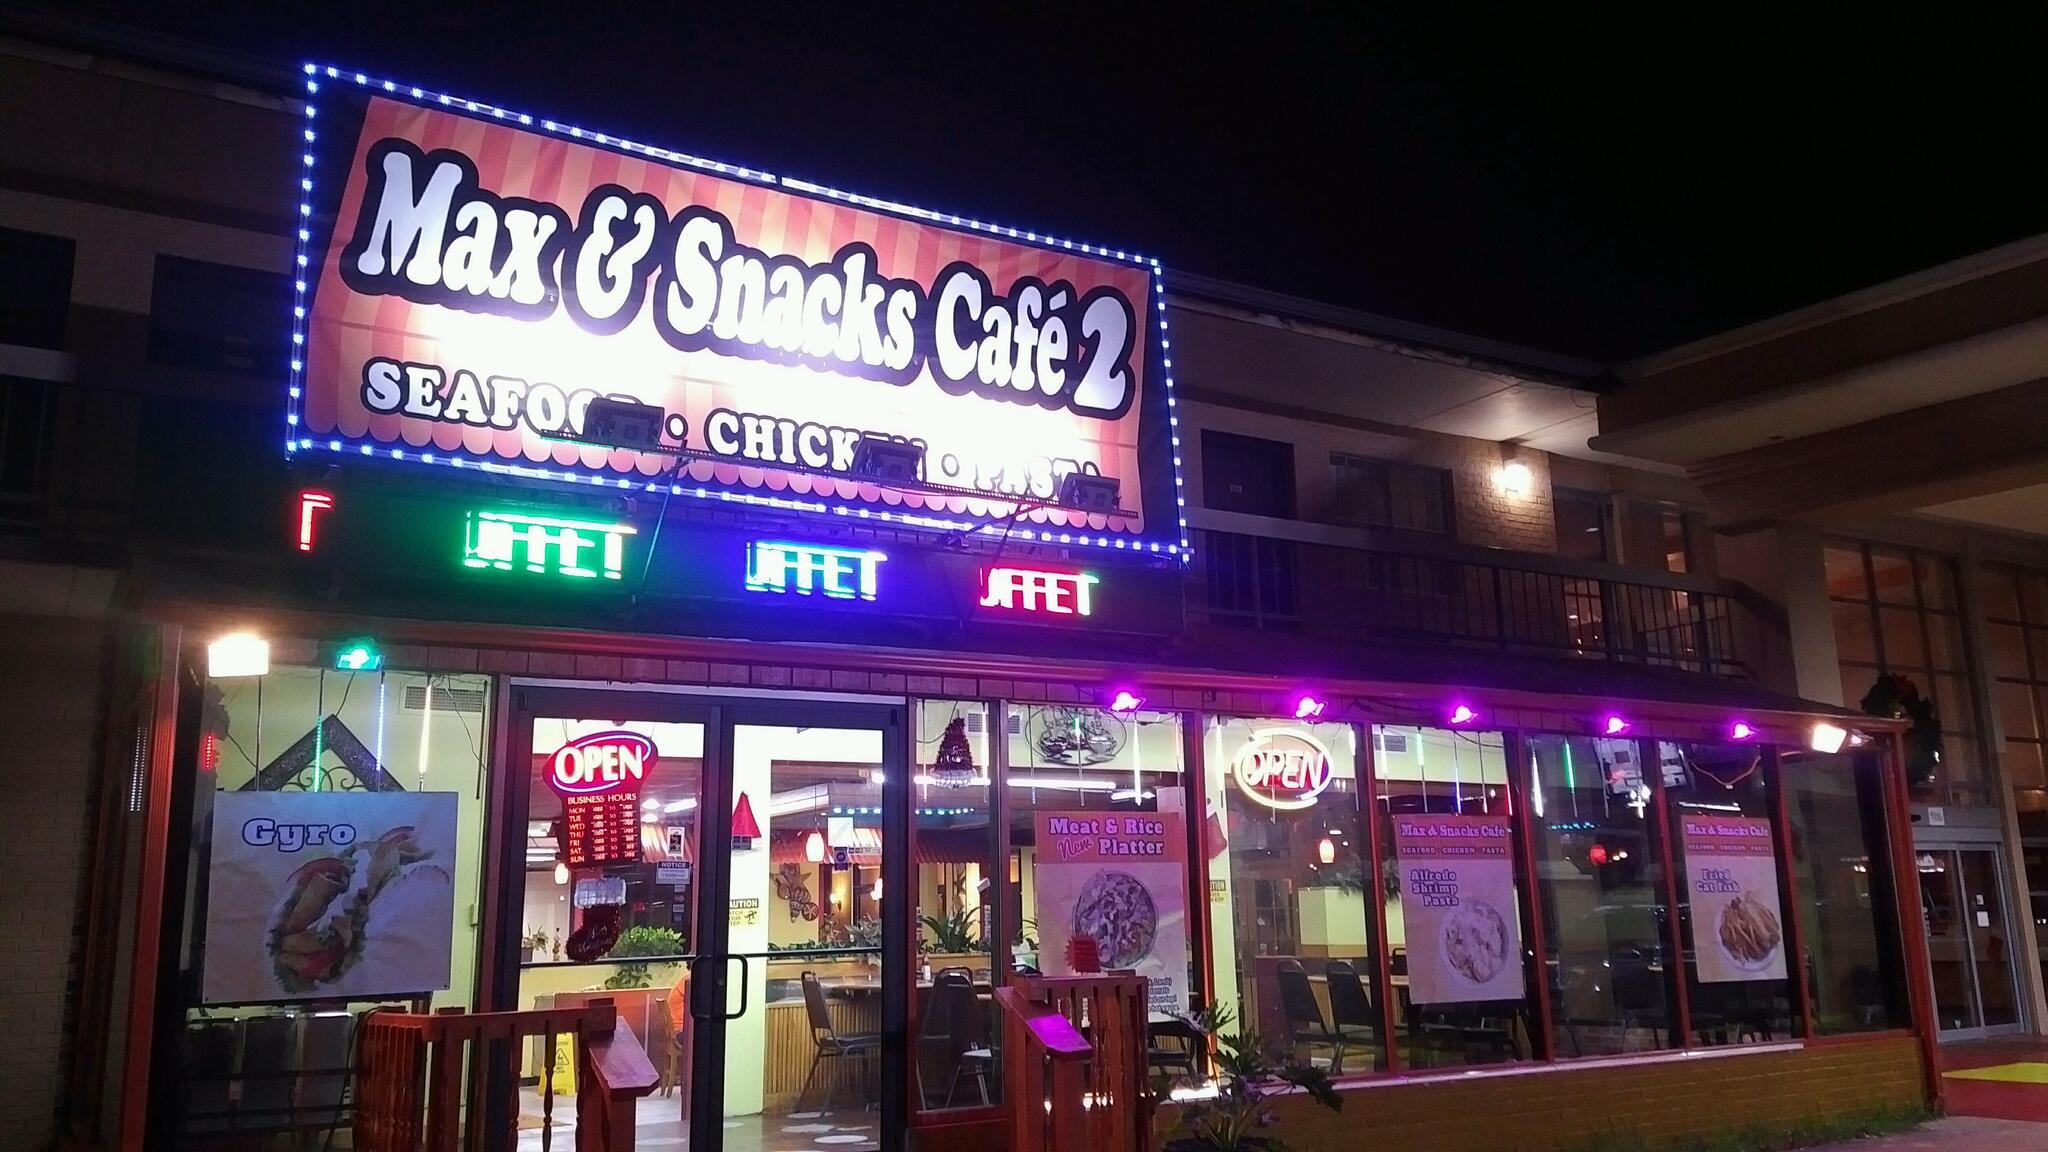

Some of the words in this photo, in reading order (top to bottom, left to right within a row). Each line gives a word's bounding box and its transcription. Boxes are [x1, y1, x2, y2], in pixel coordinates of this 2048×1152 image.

[352, 147, 562, 309] Max
[571, 191, 659, 323] &
[663, 213, 921, 374] Snacks
[931, 267, 1072, 399] Café
[1070, 292, 1132, 412] 2
[706, 412, 927, 482] CHICK
[555, 744, 643, 785] OPEN
[1243, 749, 1325, 789] OPEN
[567, 795, 605, 805] BUSINESS
[607, 793, 637, 802] HOURS
[1049, 817, 1099, 835] Meat
[1105, 818, 1119, 835] &
[1124, 818, 1164, 835] Rice
[1401, 823, 1426, 837] Max
[1440, 824, 1480, 837] Snacks
[1717, 825, 1748, 837] Snacks
[242, 818, 356, 852] Gyro
[1056, 836, 1093, 861] New
[1098, 838, 1164, 855] Platter
[570, 855, 585, 863] SUN
[1411, 869, 1457, 881] Alfredo
[1702, 868, 1730, 880] Fried
[1412, 882, 1458, 895] Shrimp
[1696, 881, 1715, 893] Cat
[1717, 881, 1741, 893] Fish
[729, 899, 758, 908] AUTION
[1423, 895, 1460, 907] Pasta
